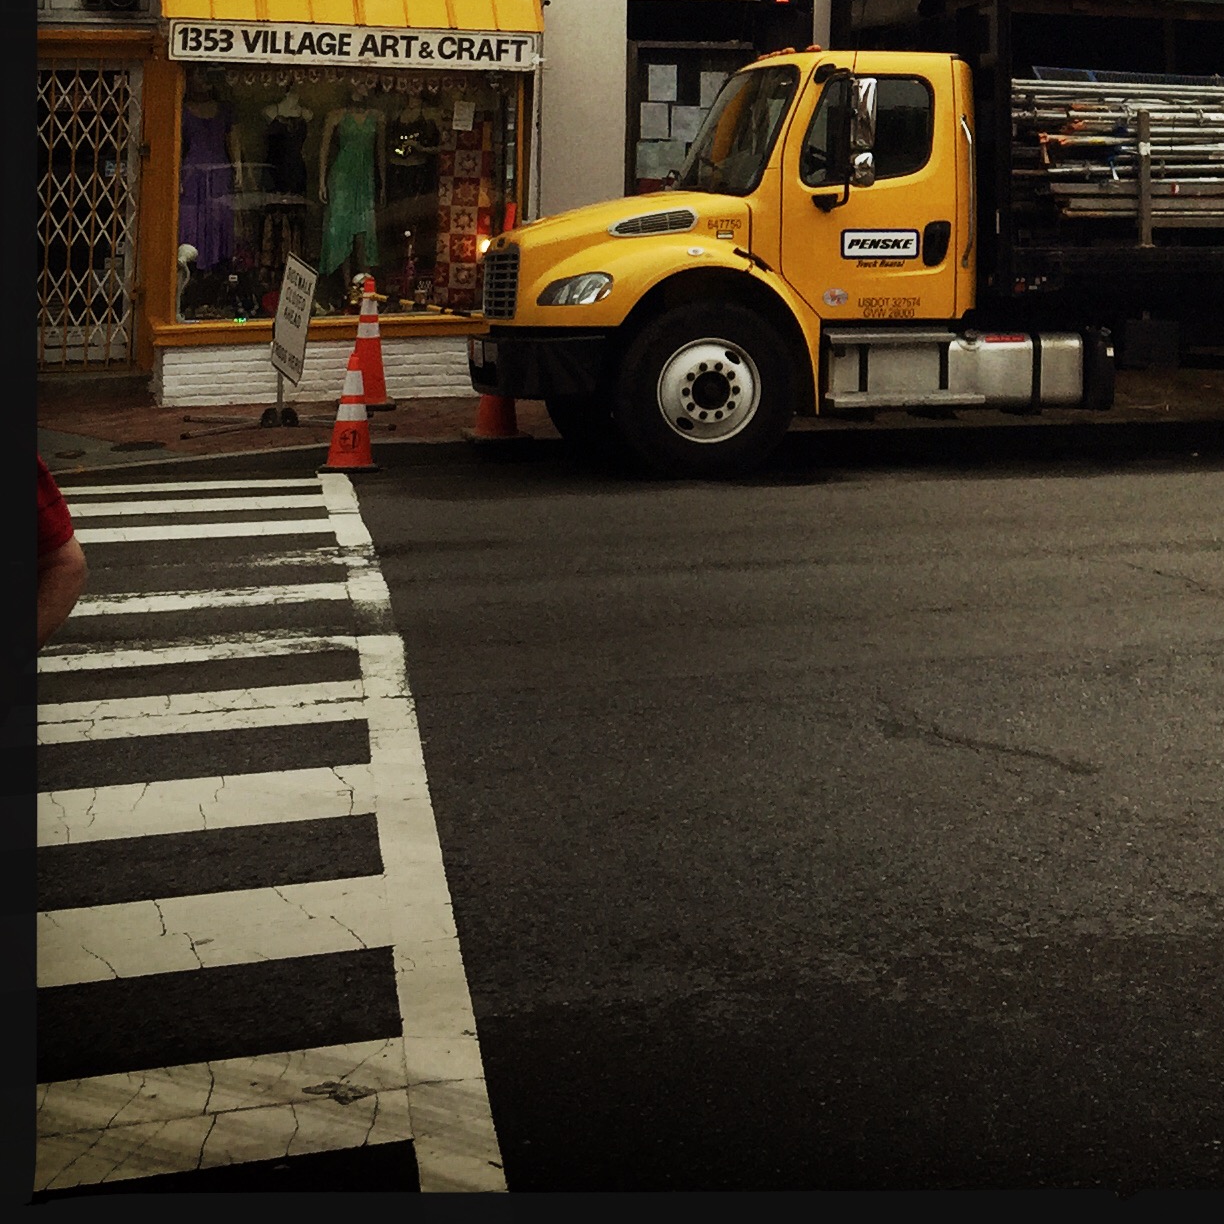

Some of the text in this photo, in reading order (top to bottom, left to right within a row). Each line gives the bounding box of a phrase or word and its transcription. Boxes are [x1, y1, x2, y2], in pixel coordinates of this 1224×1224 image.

[178, 27, 234, 52] 1353
[241, 30, 352, 56] VILLAGE
[848, 239, 914, 249] PENSKE
[858, 297, 890, 307] USDOT
